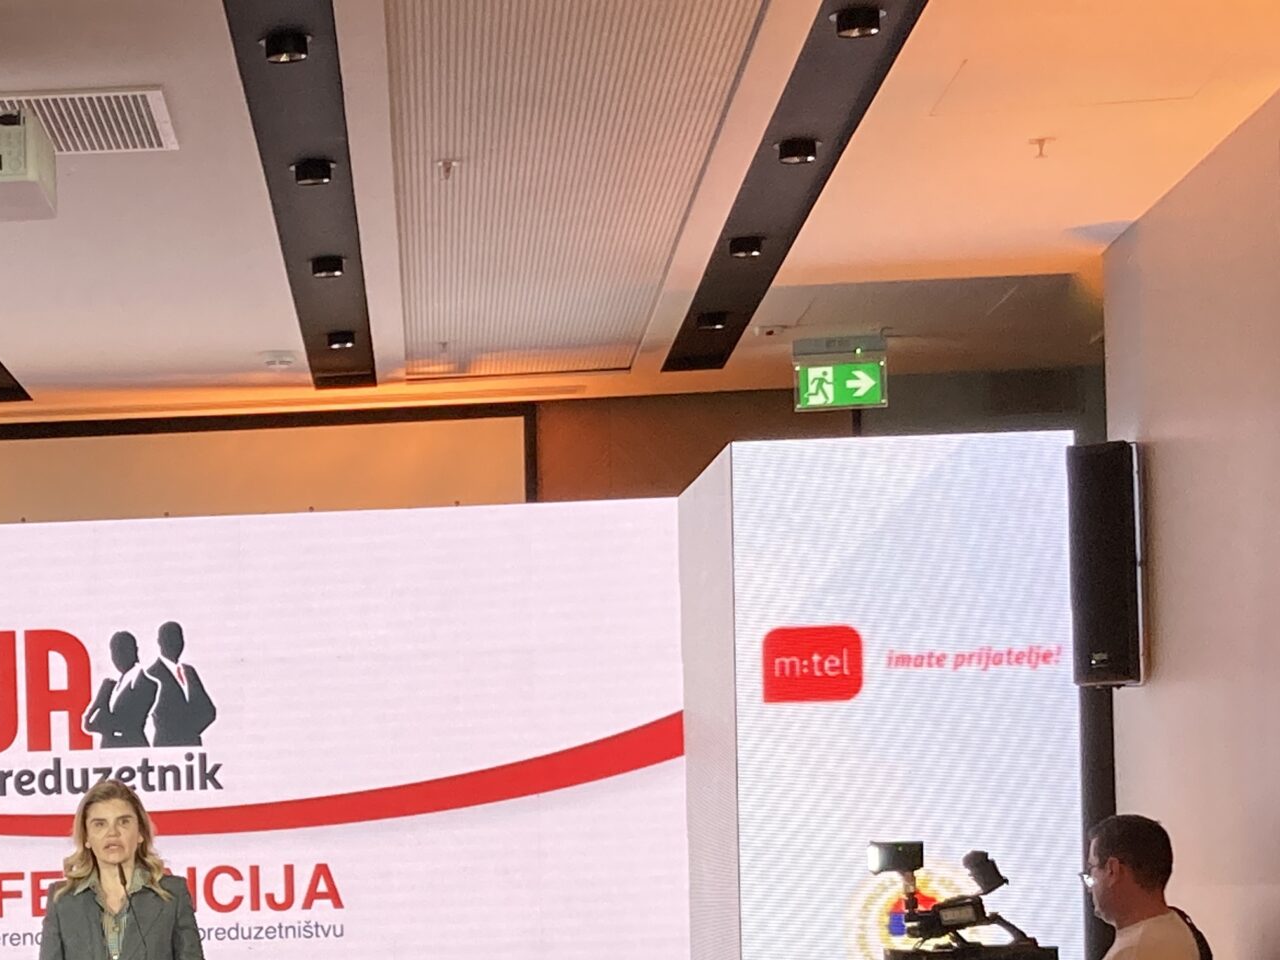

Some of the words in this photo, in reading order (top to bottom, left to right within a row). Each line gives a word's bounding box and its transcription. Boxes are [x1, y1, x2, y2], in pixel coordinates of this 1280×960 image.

[773, 648, 851, 678] m:tel
[886, 649, 946, 669] imate
[952, 645, 1062, 671] prijatelje!
